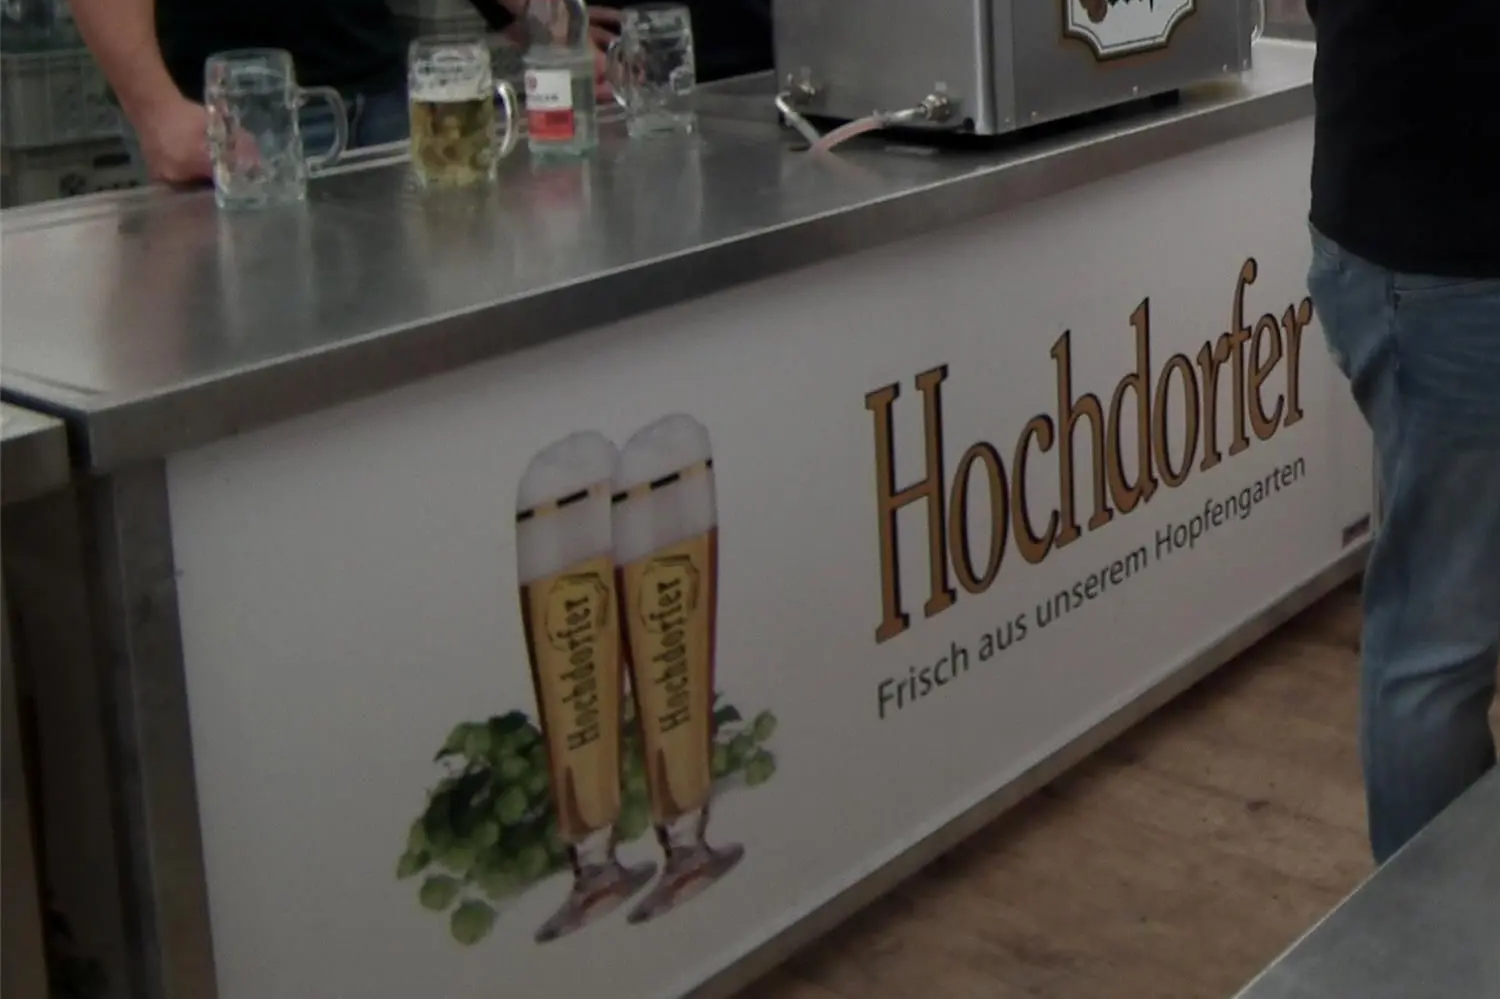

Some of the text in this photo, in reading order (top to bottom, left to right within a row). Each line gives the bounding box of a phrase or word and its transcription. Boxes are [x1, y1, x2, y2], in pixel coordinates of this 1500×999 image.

[865, 257, 1314, 645] Hochdorfer
[556, 595, 601, 751] Hochdorfer
[649, 577, 692, 734] Hochdorfer
[875, 456, 1307, 720] Frisch aus unserem Hopfengarten
